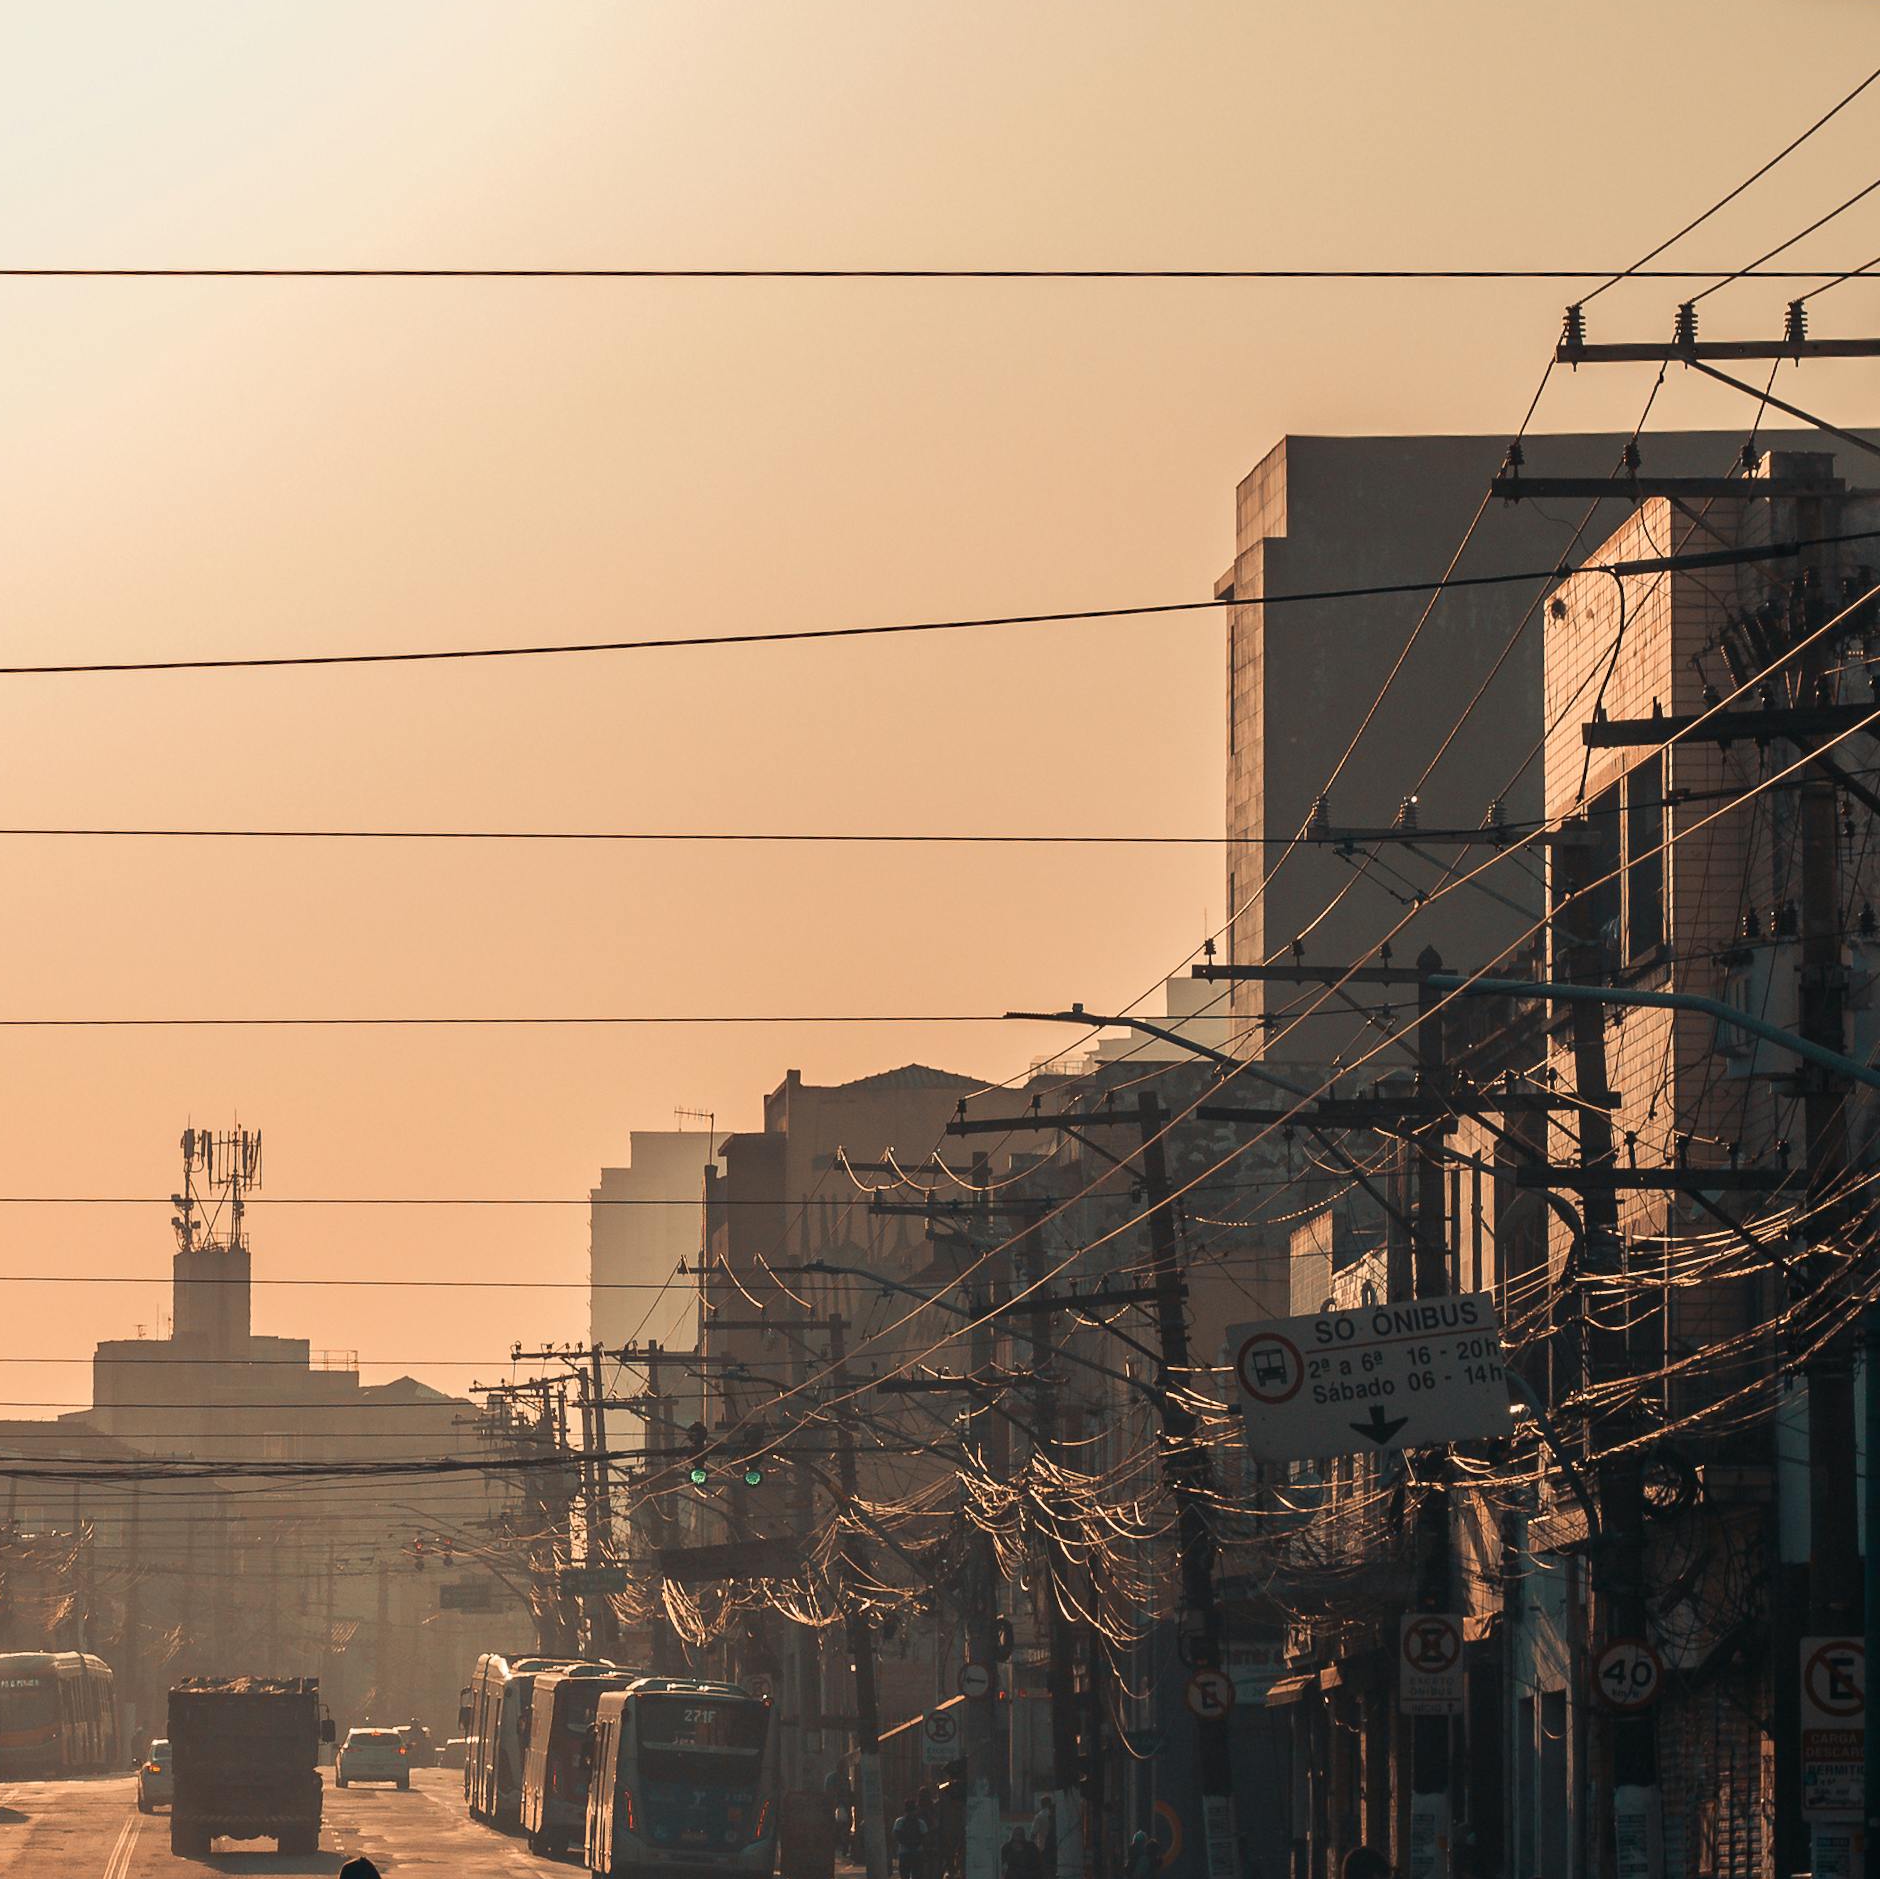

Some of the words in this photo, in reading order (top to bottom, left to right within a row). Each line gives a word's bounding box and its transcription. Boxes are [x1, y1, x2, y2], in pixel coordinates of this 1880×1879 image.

[1315, 1313, 1355, 1344] SÓ
[1372, 1301, 1478, 1337] ÔNIBUS
[1309, 1359, 1331, 1378] 2ª
[1340, 1359, 1352, 1375] a
[1362, 1352, 1383, 1371] 6ª
[1407, 1346, 1431, 1366] 16
[1457, 1339, 1498, 1361] 20h
[1313, 1378, 1395, 1404] Sábado
[1408, 1371, 1436, 1391] 06
[1464, 1363, 1503, 1386] 14h
[1603, 1659, 1652, 1688] 40
[684, 1709, 717, 1724] 271F
[1811, 1733, 1857, 1744] CARGA
